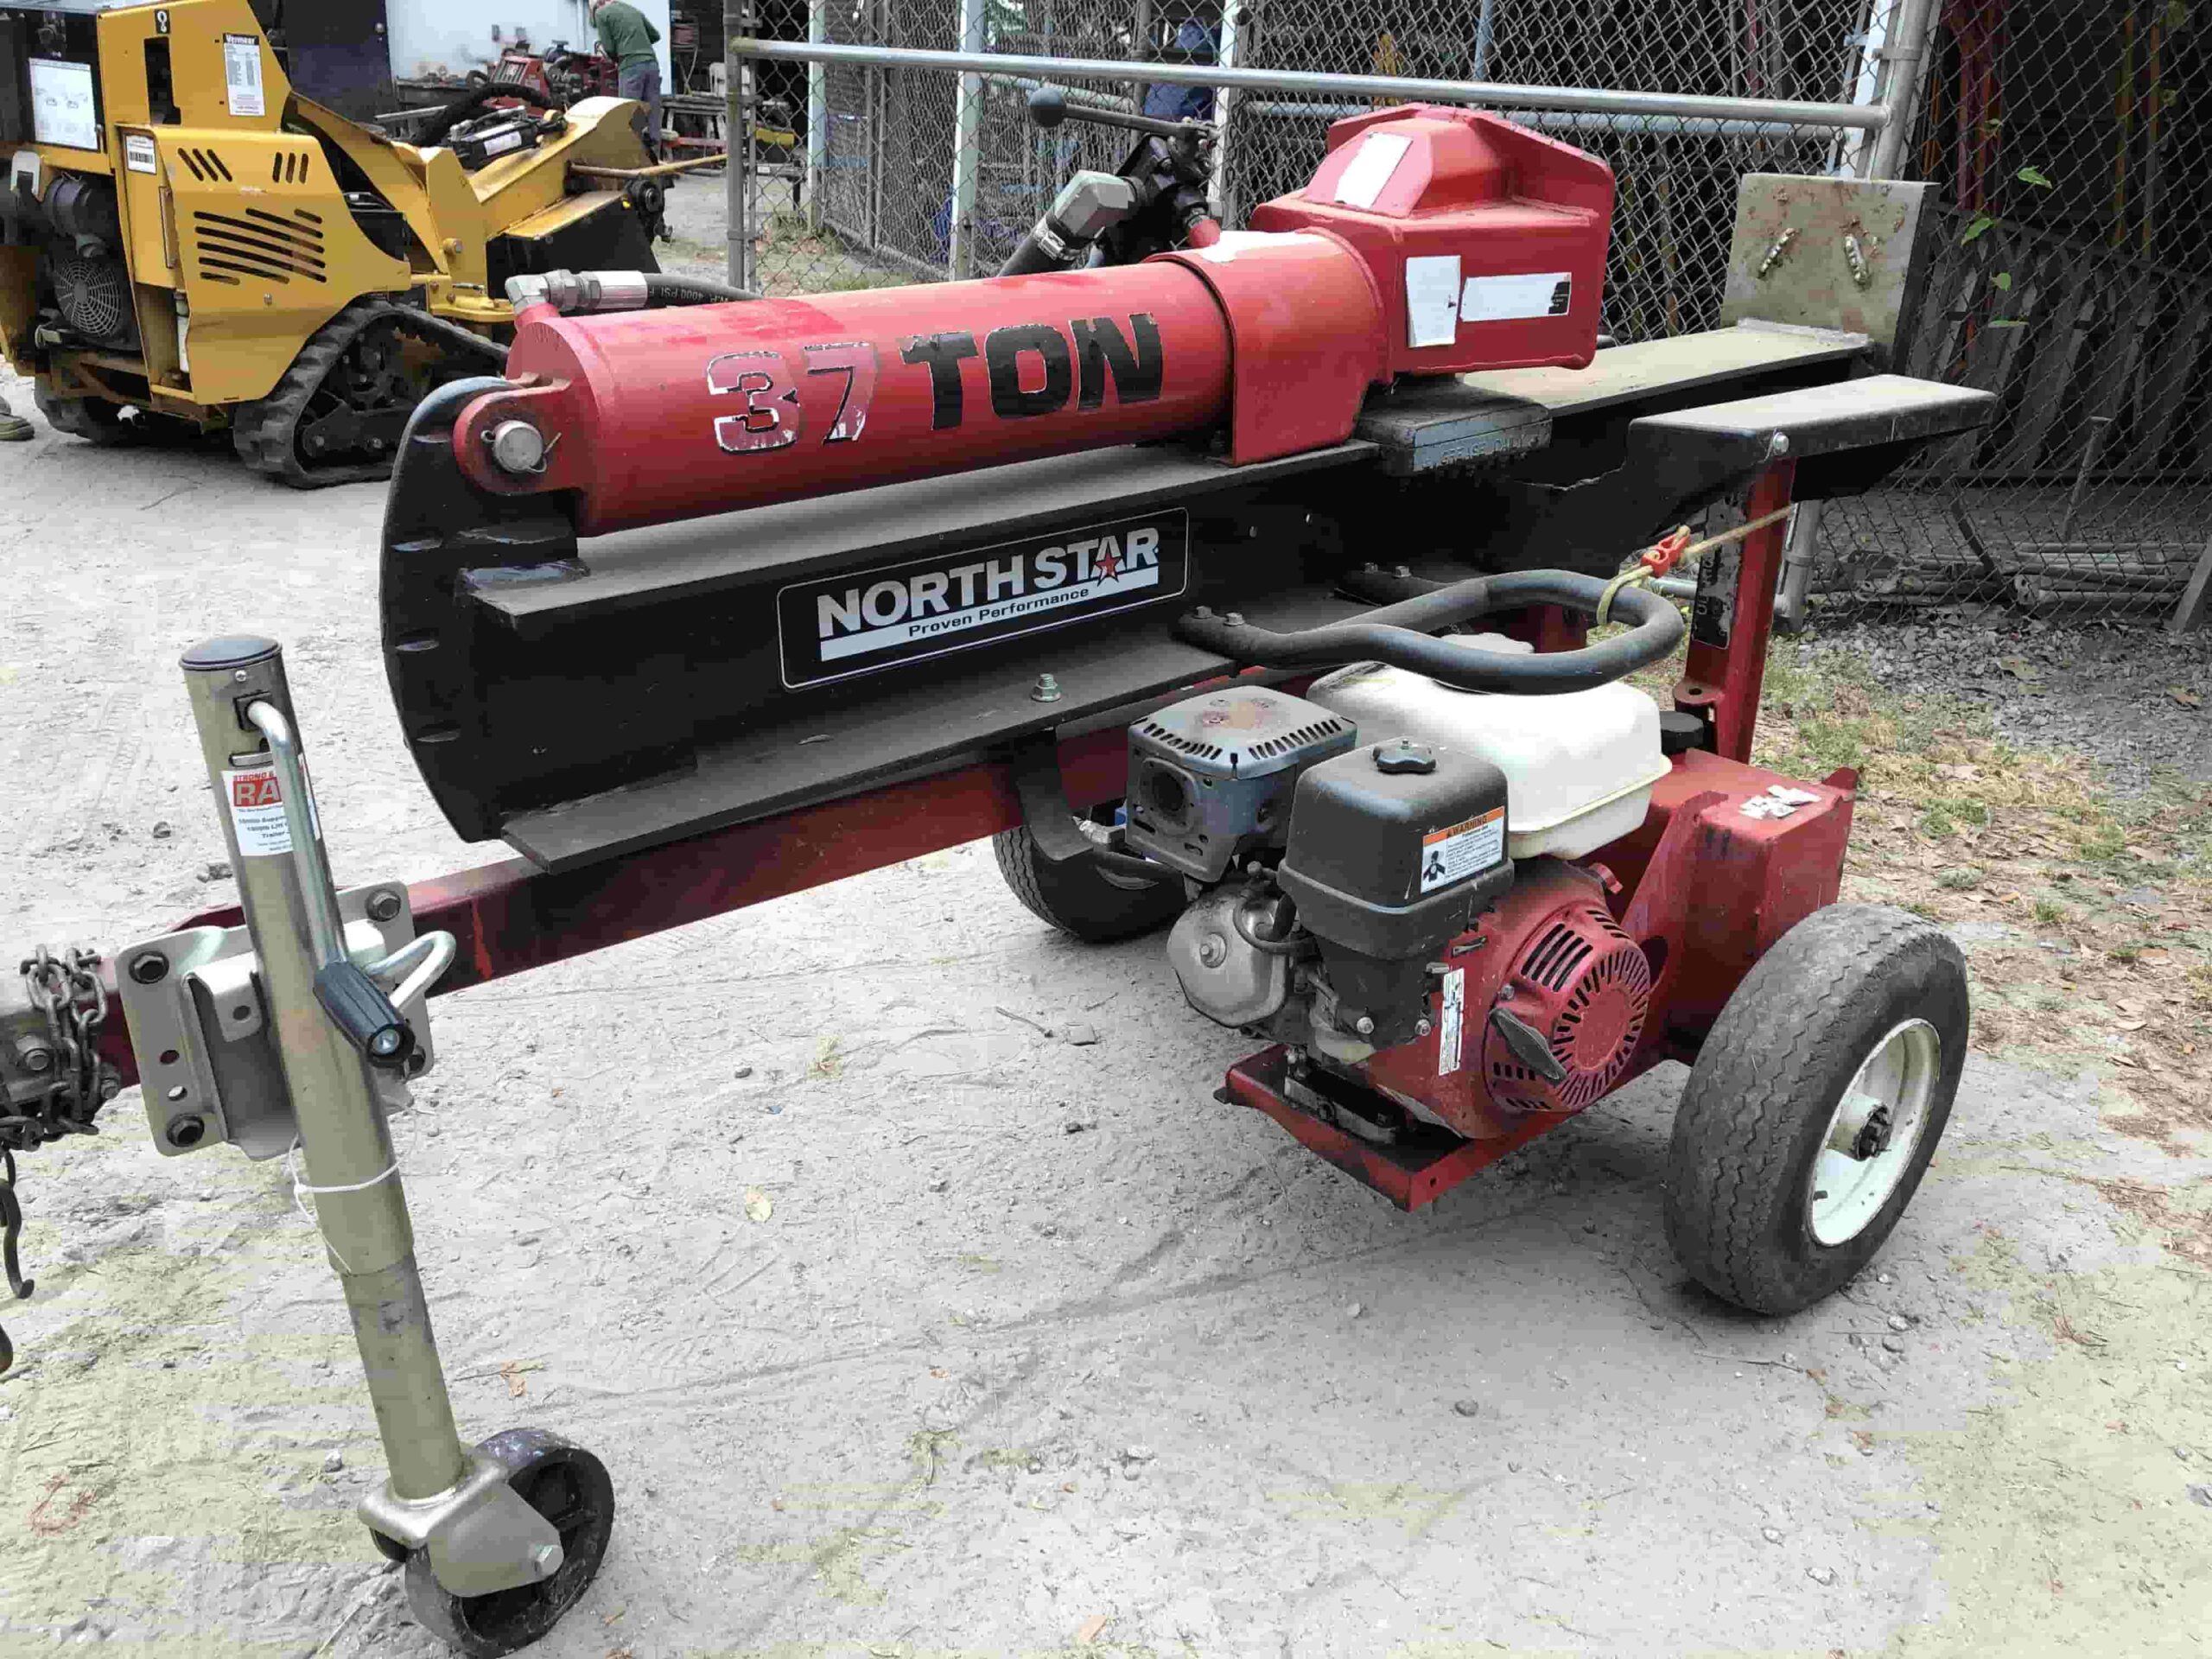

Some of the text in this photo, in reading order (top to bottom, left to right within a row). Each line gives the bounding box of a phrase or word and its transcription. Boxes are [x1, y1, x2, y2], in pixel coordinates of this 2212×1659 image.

[706, 312, 1164, 455] 37 TON
[817, 527, 1159, 638] NORTH STAR
[908, 587, 1090, 638] Proven Performance
[235, 779, 281, 805] RA
